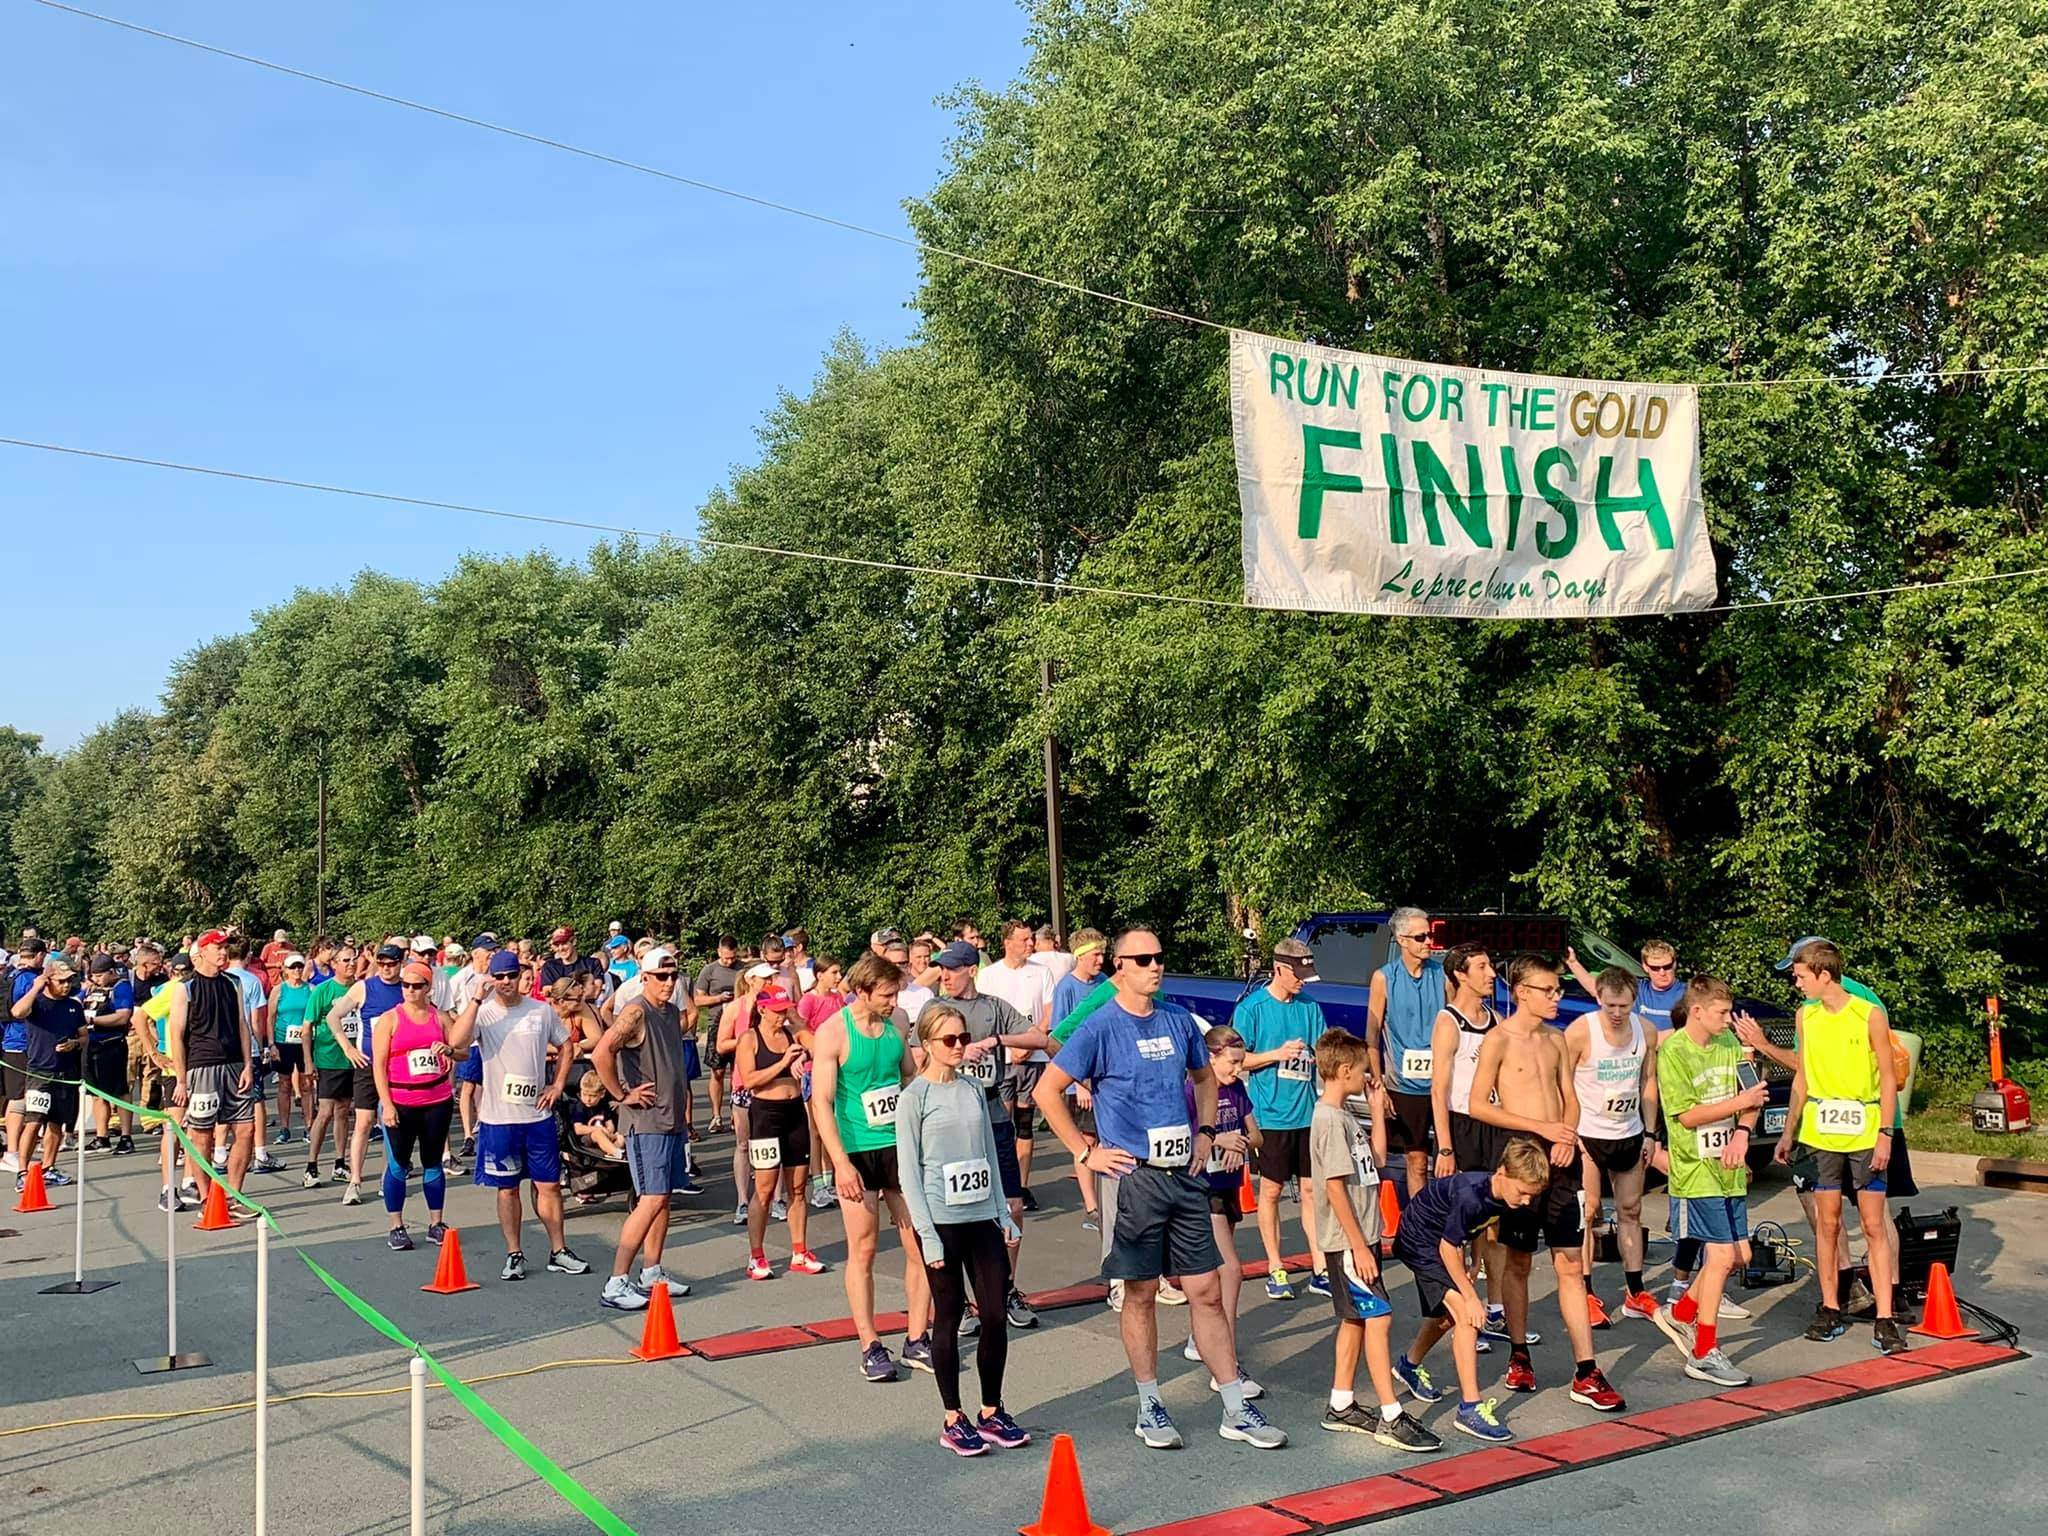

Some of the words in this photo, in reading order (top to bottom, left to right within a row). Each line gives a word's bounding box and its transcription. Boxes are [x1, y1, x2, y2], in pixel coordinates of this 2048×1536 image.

[1269, 352, 1360, 410] RUN
[1383, 371, 1464, 423] FOR
[1480, 383, 1556, 431] THE
[1570, 391, 1669, 440] GOLD
[1298, 424, 1674, 559] FINISH
[1542, 569, 1607, 605] Days
[959, 1064, 993, 1079] 1307
[506, 1082, 537, 1098] 1306
[192, 1098, 218, 1112] 1314
[1607, 1097, 1637, 1113] 1274
[1820, 1109, 1862, 1126] 1245
[750, 1147, 777, 1161] 1193
[1154, 1136, 1190, 1158] 1258
[949, 1169, 989, 1193] 1238
